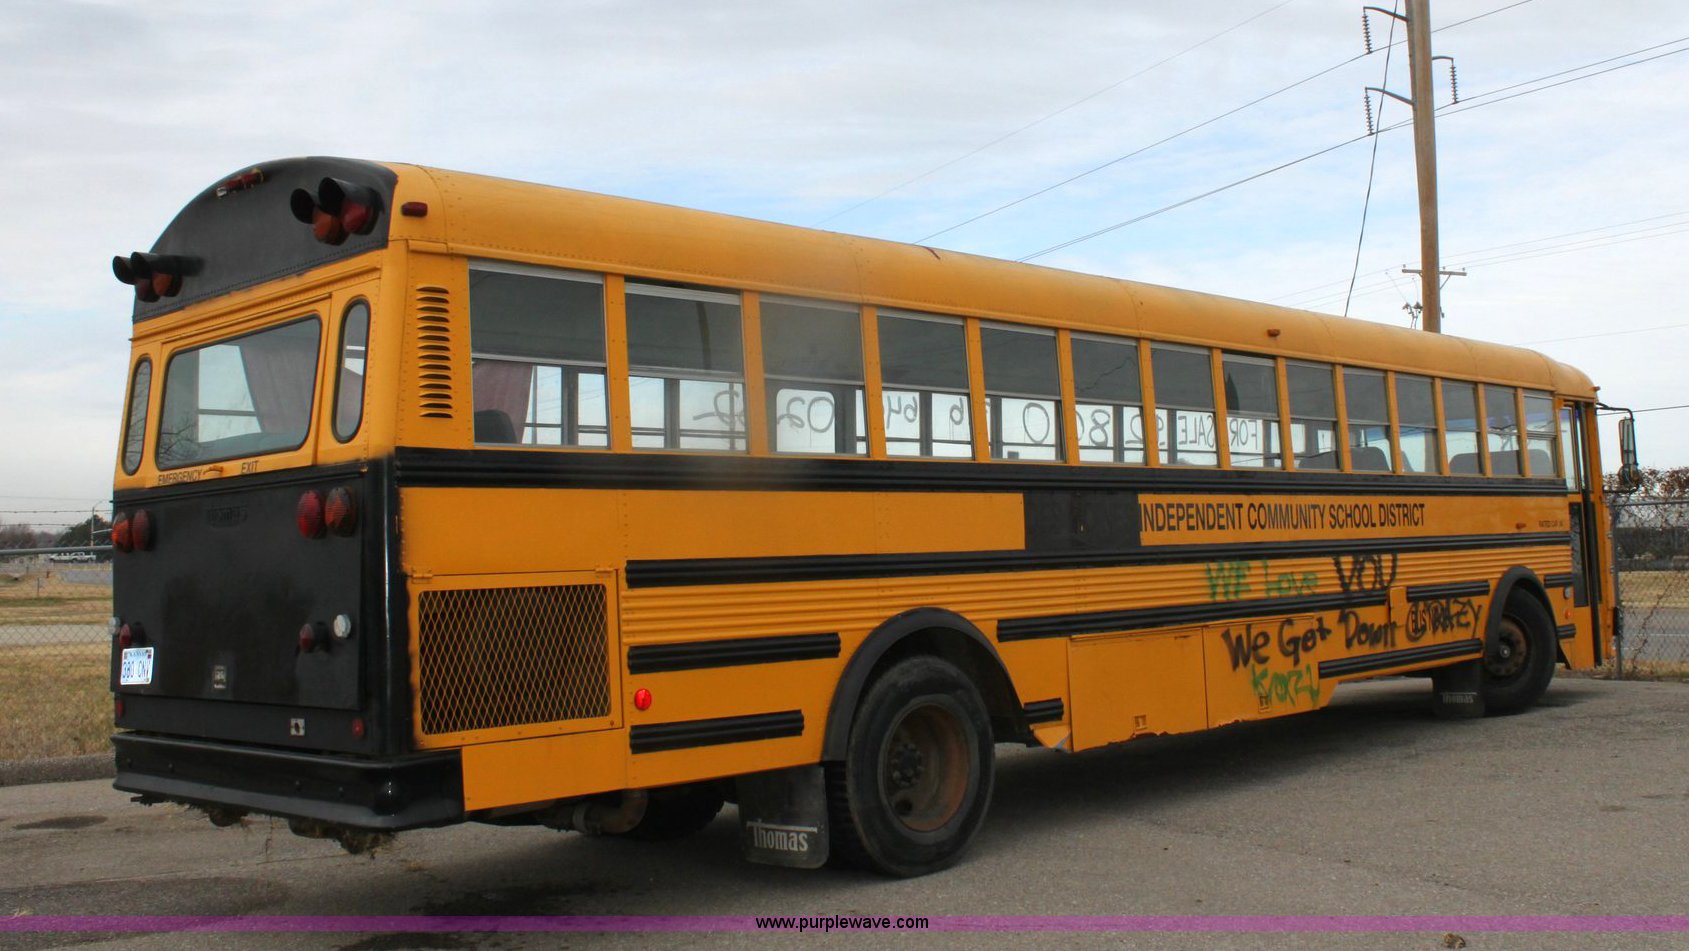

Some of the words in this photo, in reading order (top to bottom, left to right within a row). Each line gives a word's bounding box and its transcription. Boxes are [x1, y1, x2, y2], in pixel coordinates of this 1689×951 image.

[158, 469, 203, 485] EMERGENCY
[241, 460, 259, 475] EXIT
[1248, 503, 1326, 530] COMMUNITY
[1329, 503, 1377, 529] SCHOOL
[1379, 503, 1425, 527] DISTRICT
[1221, 622, 1270, 672] We
[752, 820, 809, 852] Thomas
